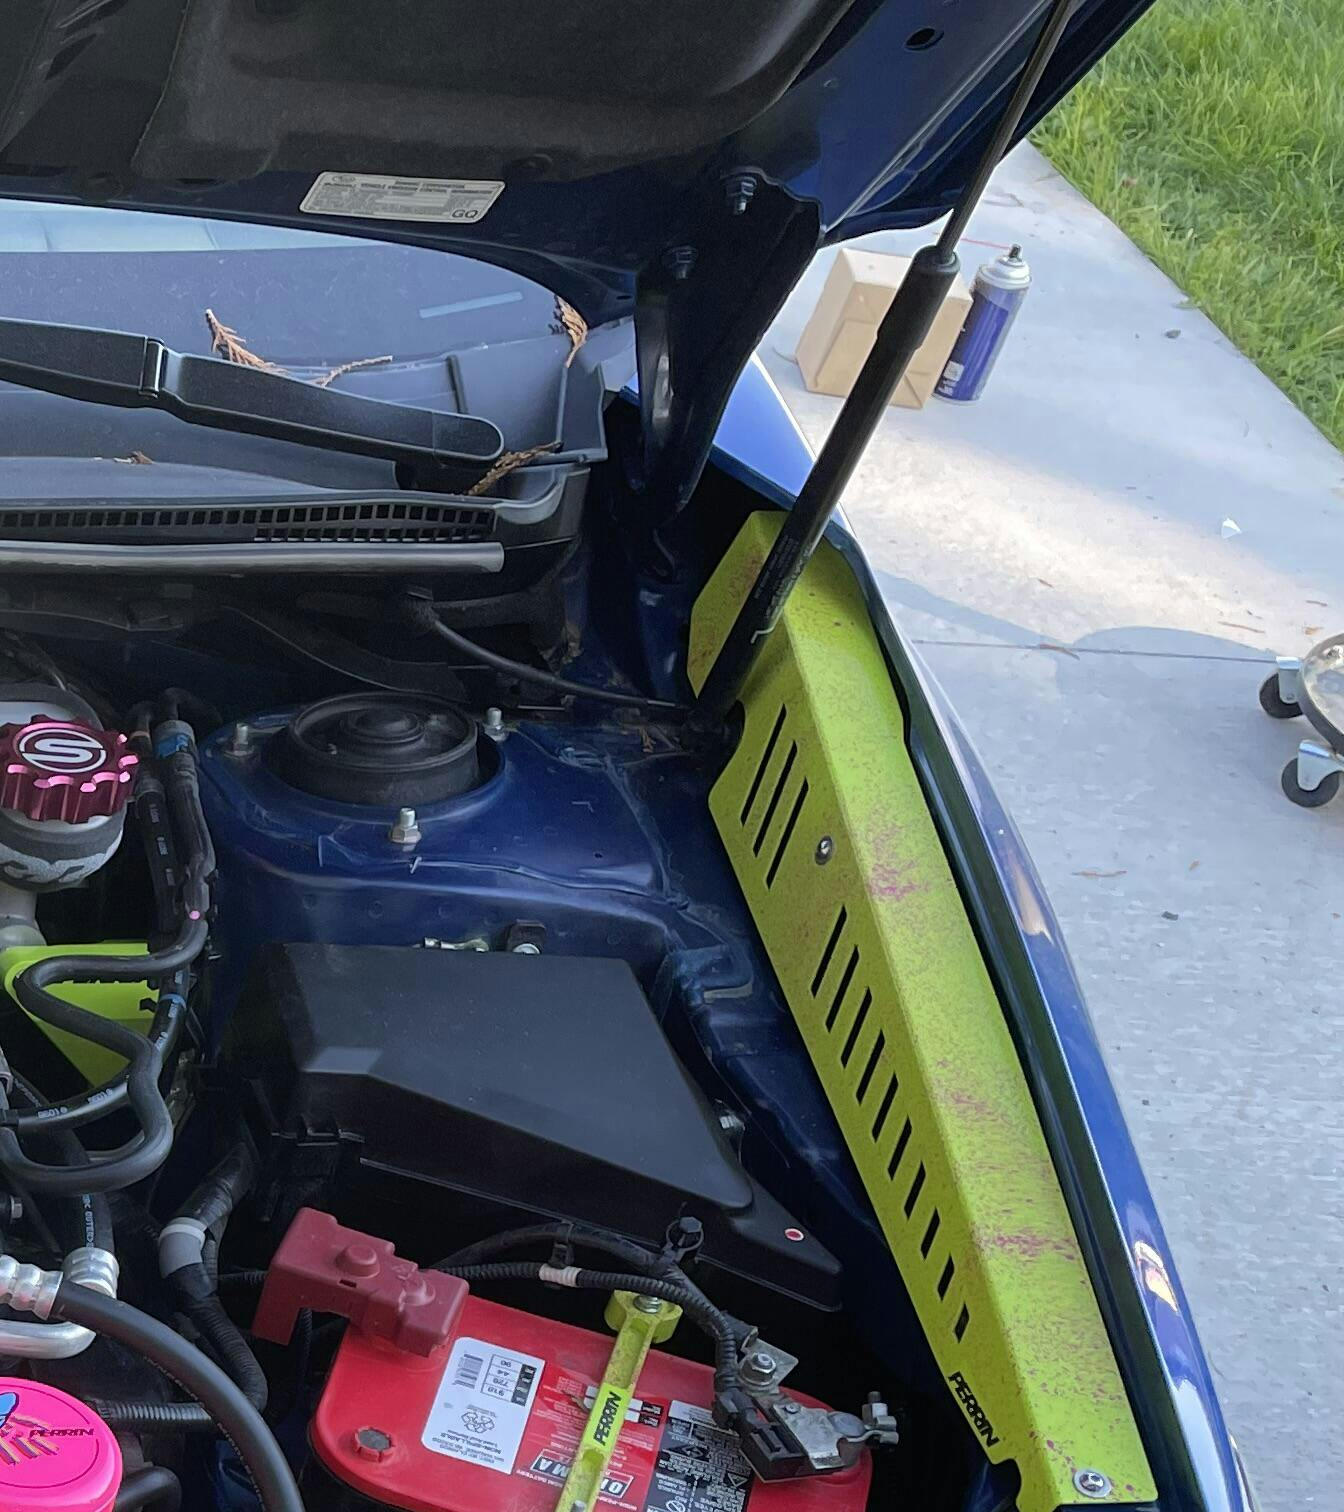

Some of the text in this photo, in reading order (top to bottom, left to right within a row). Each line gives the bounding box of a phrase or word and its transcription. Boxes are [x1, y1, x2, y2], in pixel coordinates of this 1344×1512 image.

[451, 209, 478, 218] GQ
[593, 1391, 623, 1446] PERRIN
[947, 1370, 1000, 1448] PERRIN
[29, 1428, 94, 1437] PERRIN
